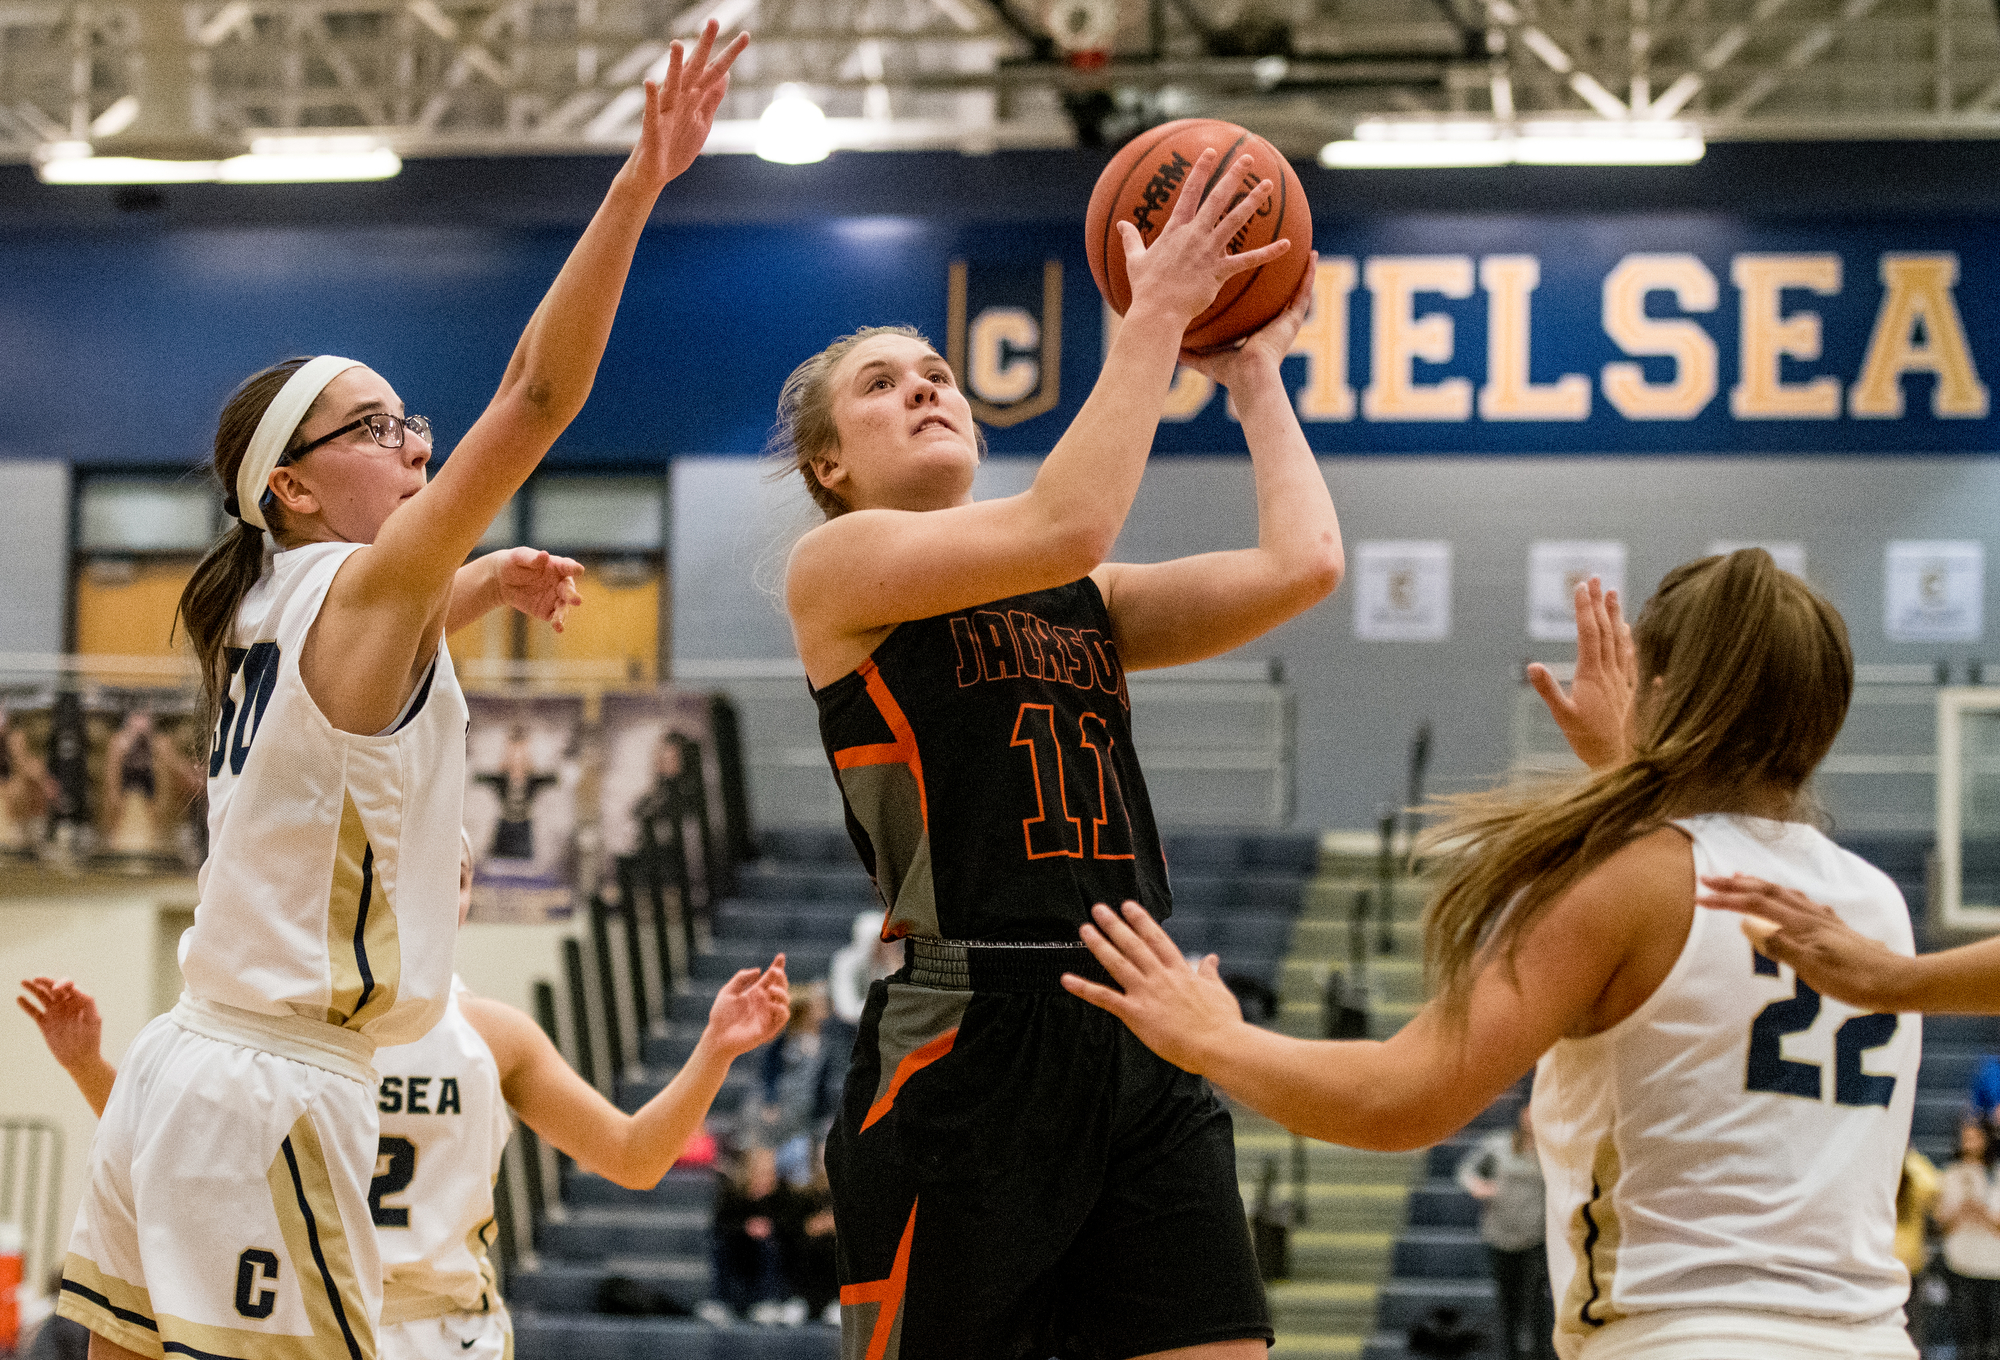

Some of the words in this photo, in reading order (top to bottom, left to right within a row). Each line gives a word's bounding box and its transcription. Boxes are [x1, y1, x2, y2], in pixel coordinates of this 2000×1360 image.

[968, 306, 1040, 404] C
[1103, 252, 1990, 421] HELSEA
[950, 610, 1130, 711] JACKSO
[1010, 703, 1135, 860] 11
[1745, 948, 1900, 1110] 22
[233, 1246, 281, 1321] C
